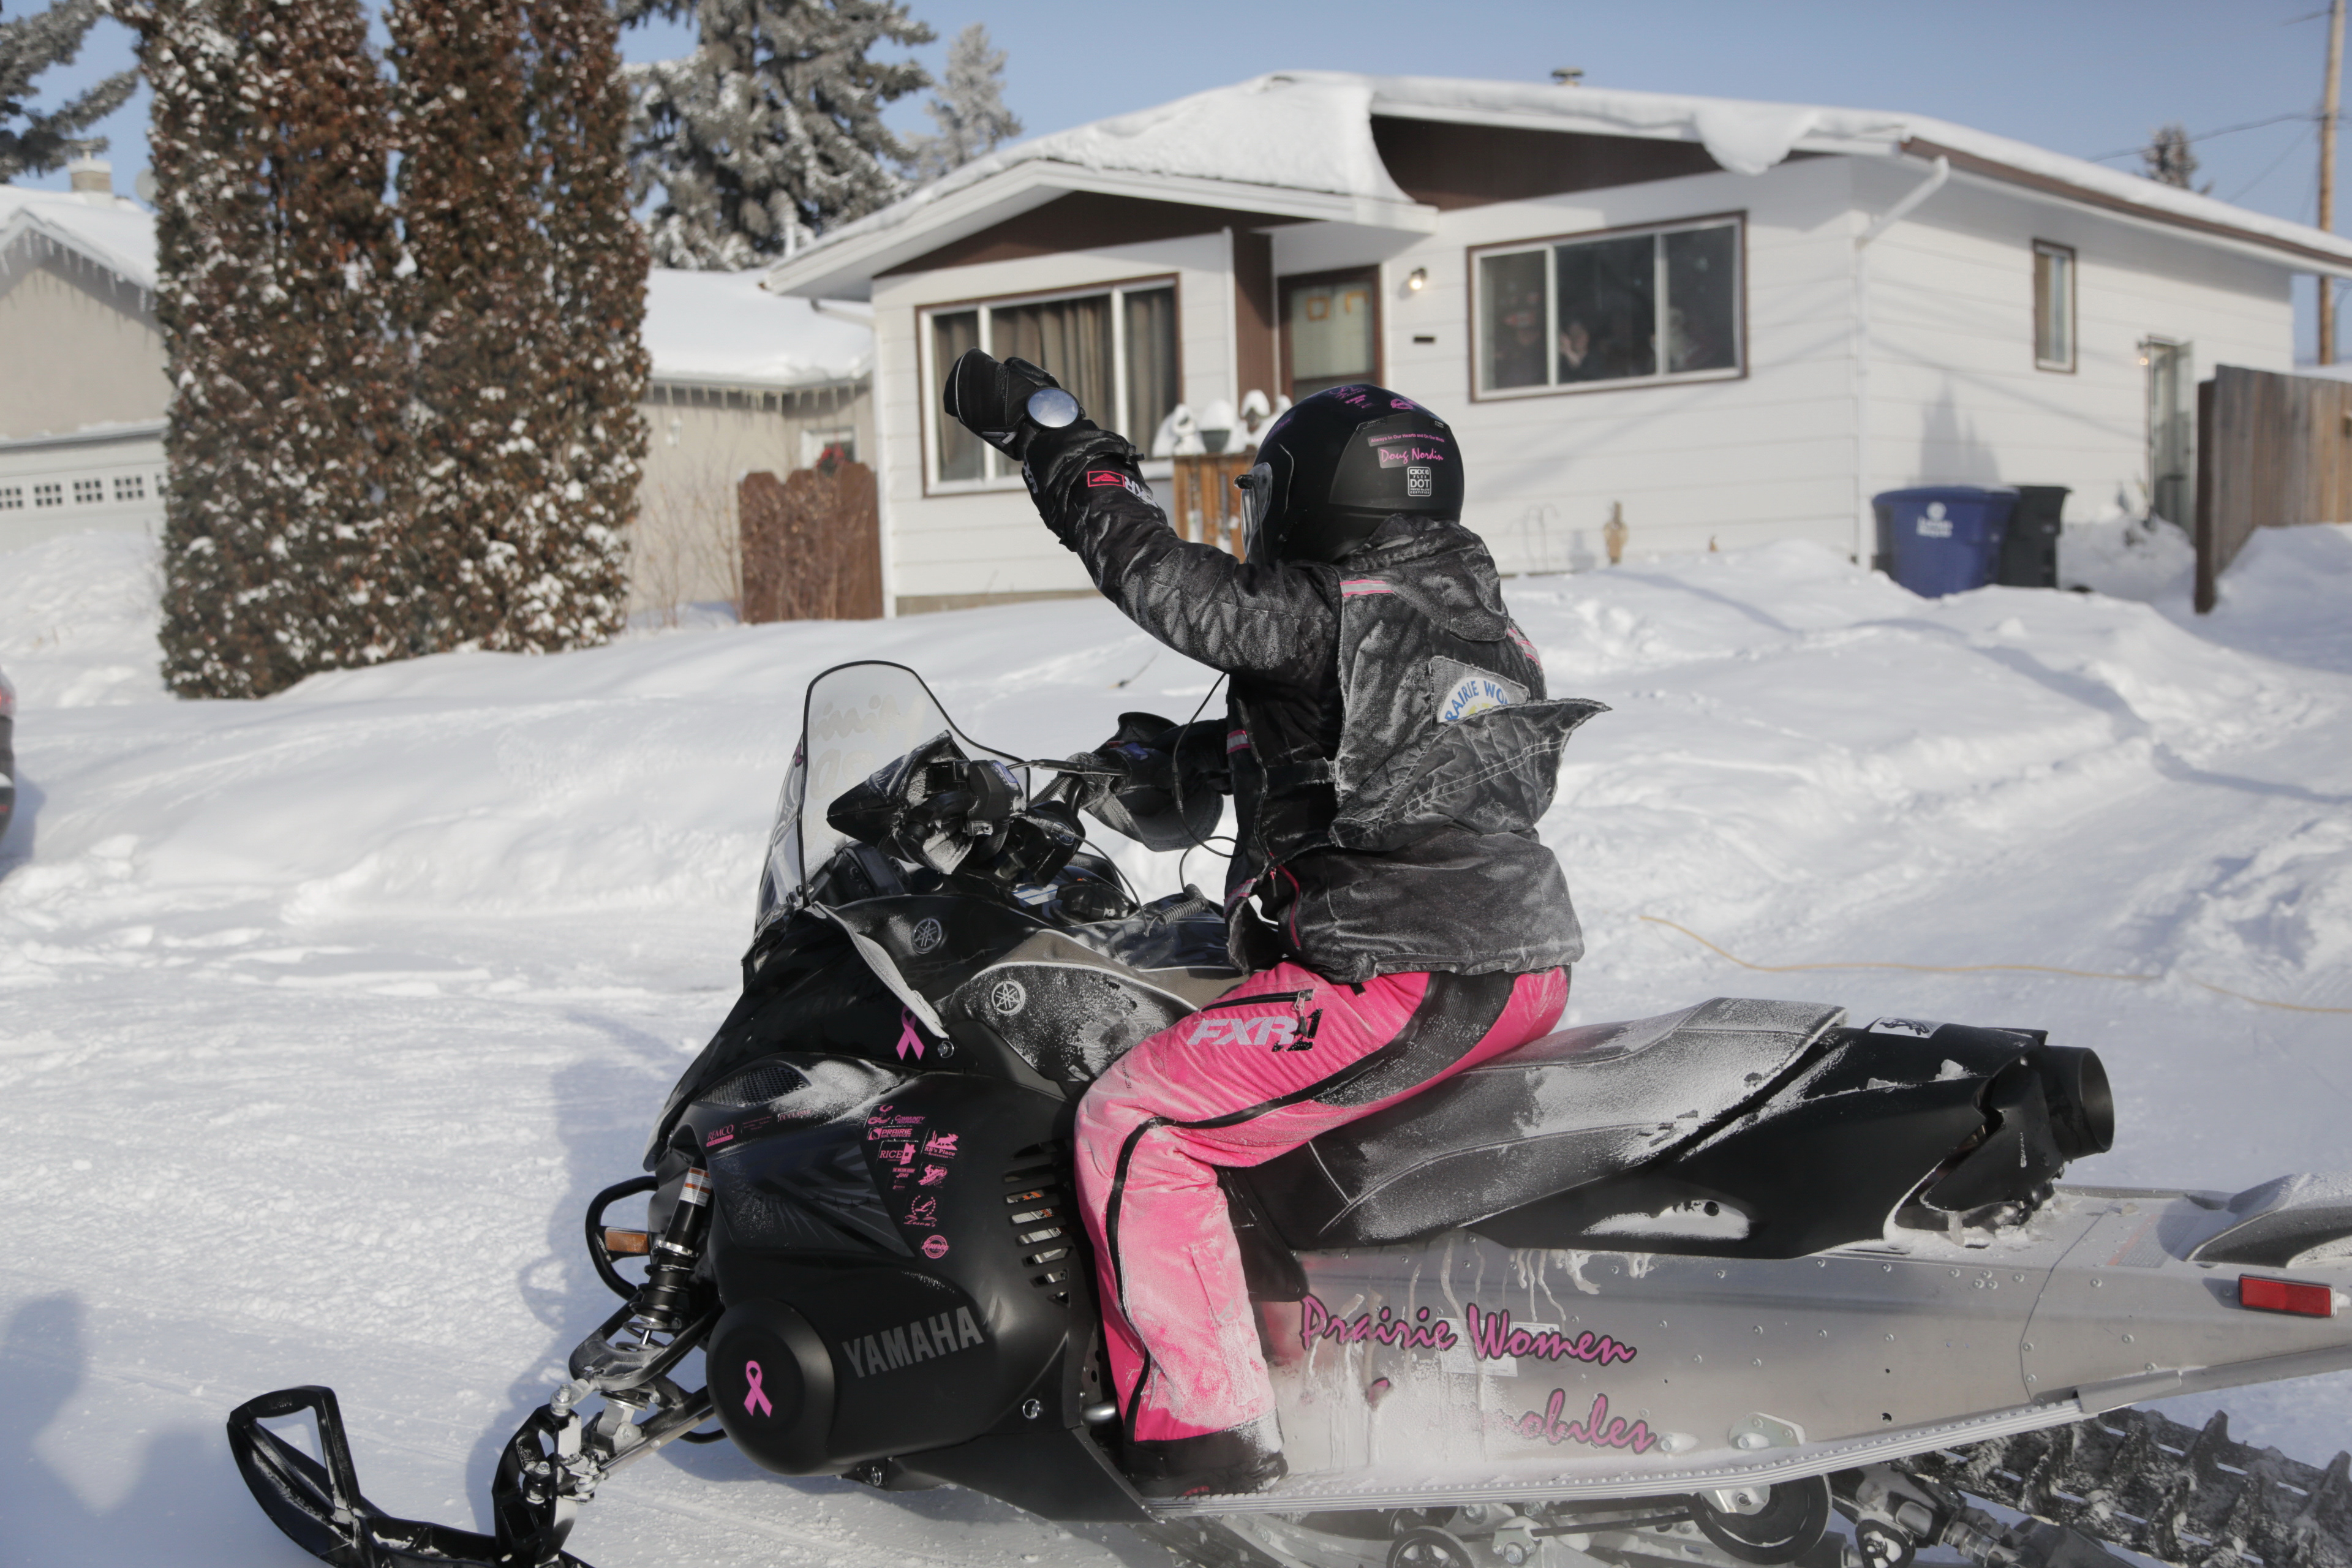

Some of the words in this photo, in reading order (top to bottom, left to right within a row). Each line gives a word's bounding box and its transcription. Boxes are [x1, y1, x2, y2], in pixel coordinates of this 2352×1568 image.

[1380, 448, 1409, 464] Doug
[1412, 447, 1444, 461] Nordin
[1410, 479, 1430, 488] DOT
[1444, 680, 1479, 721] RAIRIE
[1186, 1016, 1298, 1046] FXR
[707, 1124, 734, 1141] REMCO
[879, 1150, 903, 1159] RICE
[1301, 1293, 1458, 1351] Prairie
[1467, 1302, 1637, 1366] Women
[841, 1305, 984, 1378] YAMAHA
